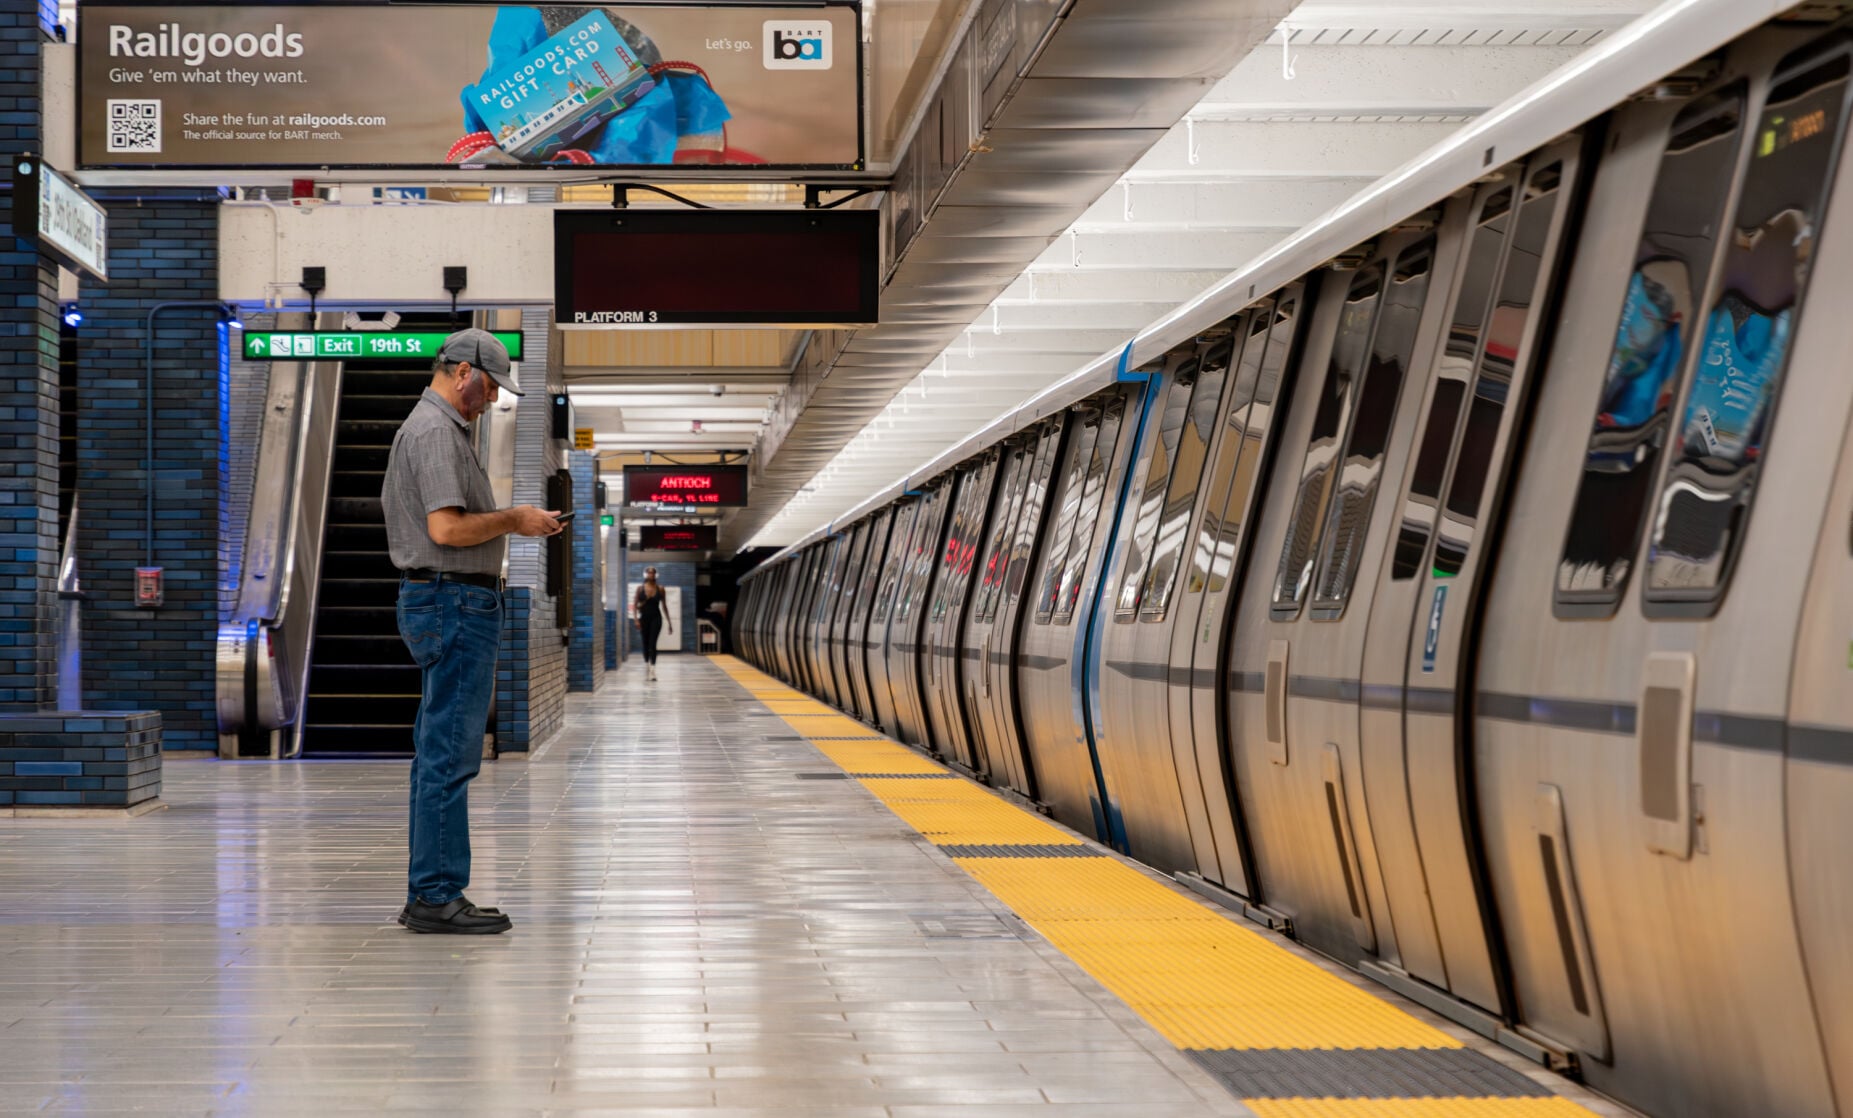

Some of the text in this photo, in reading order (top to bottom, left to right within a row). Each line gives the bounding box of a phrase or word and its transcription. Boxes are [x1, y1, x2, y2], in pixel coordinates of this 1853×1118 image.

[109, 23, 304, 66] Railgoods
[734, 41, 753, 52] go.
[480, 22, 602, 104] RAILGOODS.COM
[109, 68, 143, 83] Give
[182, 68, 221, 83] what
[226, 68, 259, 86] they
[263, 69, 307, 83] want.
[500, 40, 599, 109] GIFT CARD
[183, 113, 386, 128] Share the fun at railgoods.com
[183, 130, 343, 140] The official source for BART merch.
[574, 311, 658, 323] PLATFORM 3
[324, 338, 422, 352] Exit 19th St
[660, 476, 711, 488] ANTIOCH
